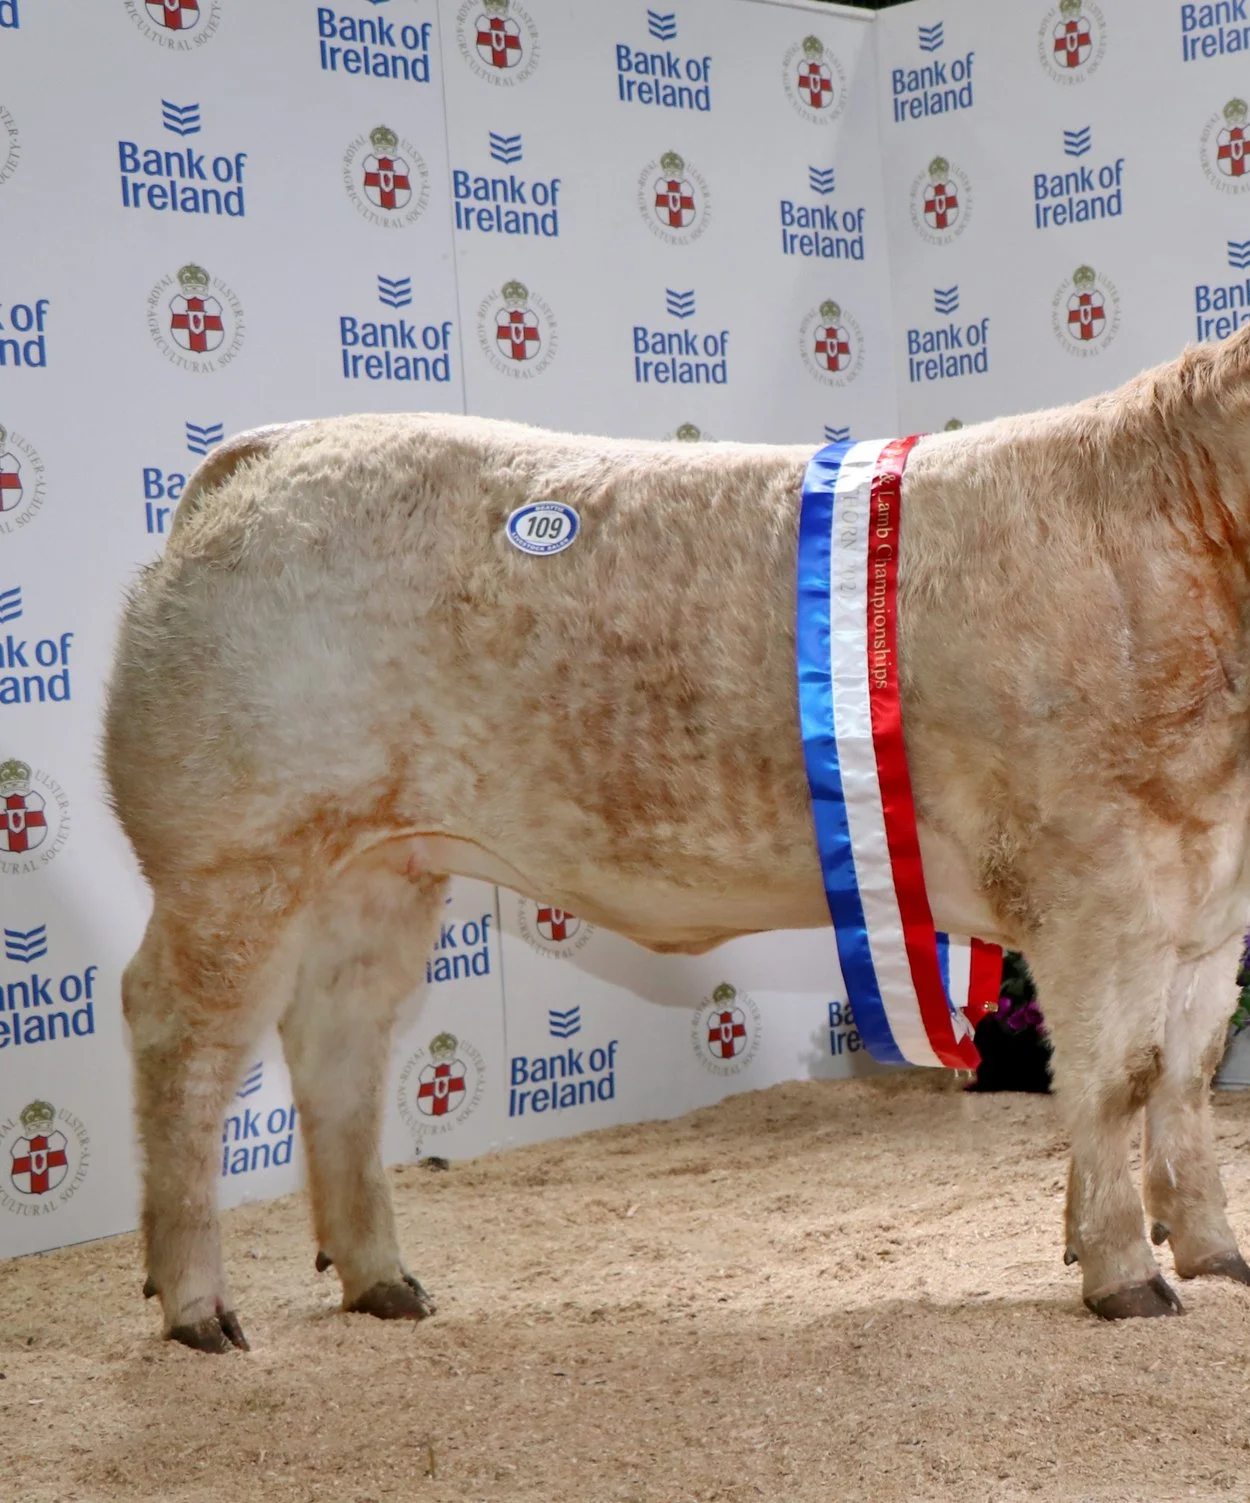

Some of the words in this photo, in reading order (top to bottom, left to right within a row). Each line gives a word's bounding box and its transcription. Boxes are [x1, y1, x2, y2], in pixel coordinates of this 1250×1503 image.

[124, 0, 192, 52] RICULTURAL
[317, 7, 396, 47] Bank
[401, 22, 432, 52] of
[511, 0, 539, 38] ULSTER
[1182, 0, 1247, 33] Bank
[320, 39, 431, 82] Ireland
[457, 31, 515, 87] AGRICULTURAL
[517, 40, 541, 82] SOCIETY
[615, 43, 682, 79] Bank
[686, 56, 710, 82] of
[892, 62, 948, 96] Bank
[950, 52, 975, 83] of
[617, 74, 712, 113] Ireland
[894, 81, 975, 121] Ireland
[1201, 112, 1221, 142] ROYAL
[119, 140, 207, 180] Bank
[213, 151, 246, 183] of
[346, 135, 367, 165] ROYAL
[401, 138, 430, 178] ULSTER
[1200, 149, 1250, 195] AGRICULTURAL
[121, 175, 246, 217] Ireland
[343, 173, 405, 229] AGRICULTURAL
[406, 180, 432, 224] SOCIETY
[453, 169, 527, 204] Bank
[532, 178, 559, 206] of
[1033, 167, 1095, 202] Bank
[1099, 159, 1124, 189] of
[455, 201, 560, 237] Ireland
[780, 200, 839, 231] Bank
[843, 207, 864, 233] of
[1034, 189, 1123, 230] Ireland
[781, 227, 865, 261] Ireland
[10, 299, 50, 332] of
[149, 275, 173, 307] ROYAL
[212, 277, 244, 318] ULSTER
[478, 291, 500, 320] ROYAL
[530, 292, 556, 328] ULSTER
[147, 315, 217, 373] AGRICULTURAL
[218, 320, 247, 367] SOCIETY
[340, 315, 417, 348] Bank
[422, 321, 450, 350] of
[478, 326, 534, 380] AGRICULTURAL
[534, 331, 558, 375] SOCIETY
[633, 326, 699, 355] Bank
[703, 331, 729, 359] of
[907, 325, 964, 356] Bank
[967, 319, 988, 346] of
[343, 348, 452, 382] Ireland
[635, 355, 728, 385] Ireland
[910, 347, 990, 381] Ireland
[10, 431, 45, 473] ULSTER
[15, 475, 47, 529] SOCIETY
[143, 467, 186, 500] Ba
[527, 515, 563, 540] 109
[876, 491, 895, 539] Lamb
[870, 543, 893, 690] Championships
[35, 632, 75, 668] of
[34, 768, 70, 809] ULSTER
[41, 813, 71, 863] SOCIETY
[462, 913, 493, 946] of
[60, 965, 98, 1002] of
[426, 946, 490, 983] land
[399, 1048, 426, 1080] ROYAL
[460, 1038, 486, 1073] ULSTER
[511, 1048, 585, 1087] Bank
[589, 1040, 617, 1073] of
[396, 1088, 454, 1137] AGRICULTURAL
[457, 1079, 486, 1126] SOCIETY
[510, 1071, 616, 1118] Ireland
[58, 1108, 90, 1144] ULSTER
[222, 1108, 261, 1143] nk
[222, 1133, 294, 1177] land
[60, 1153, 91, 1204] SOCIETY
